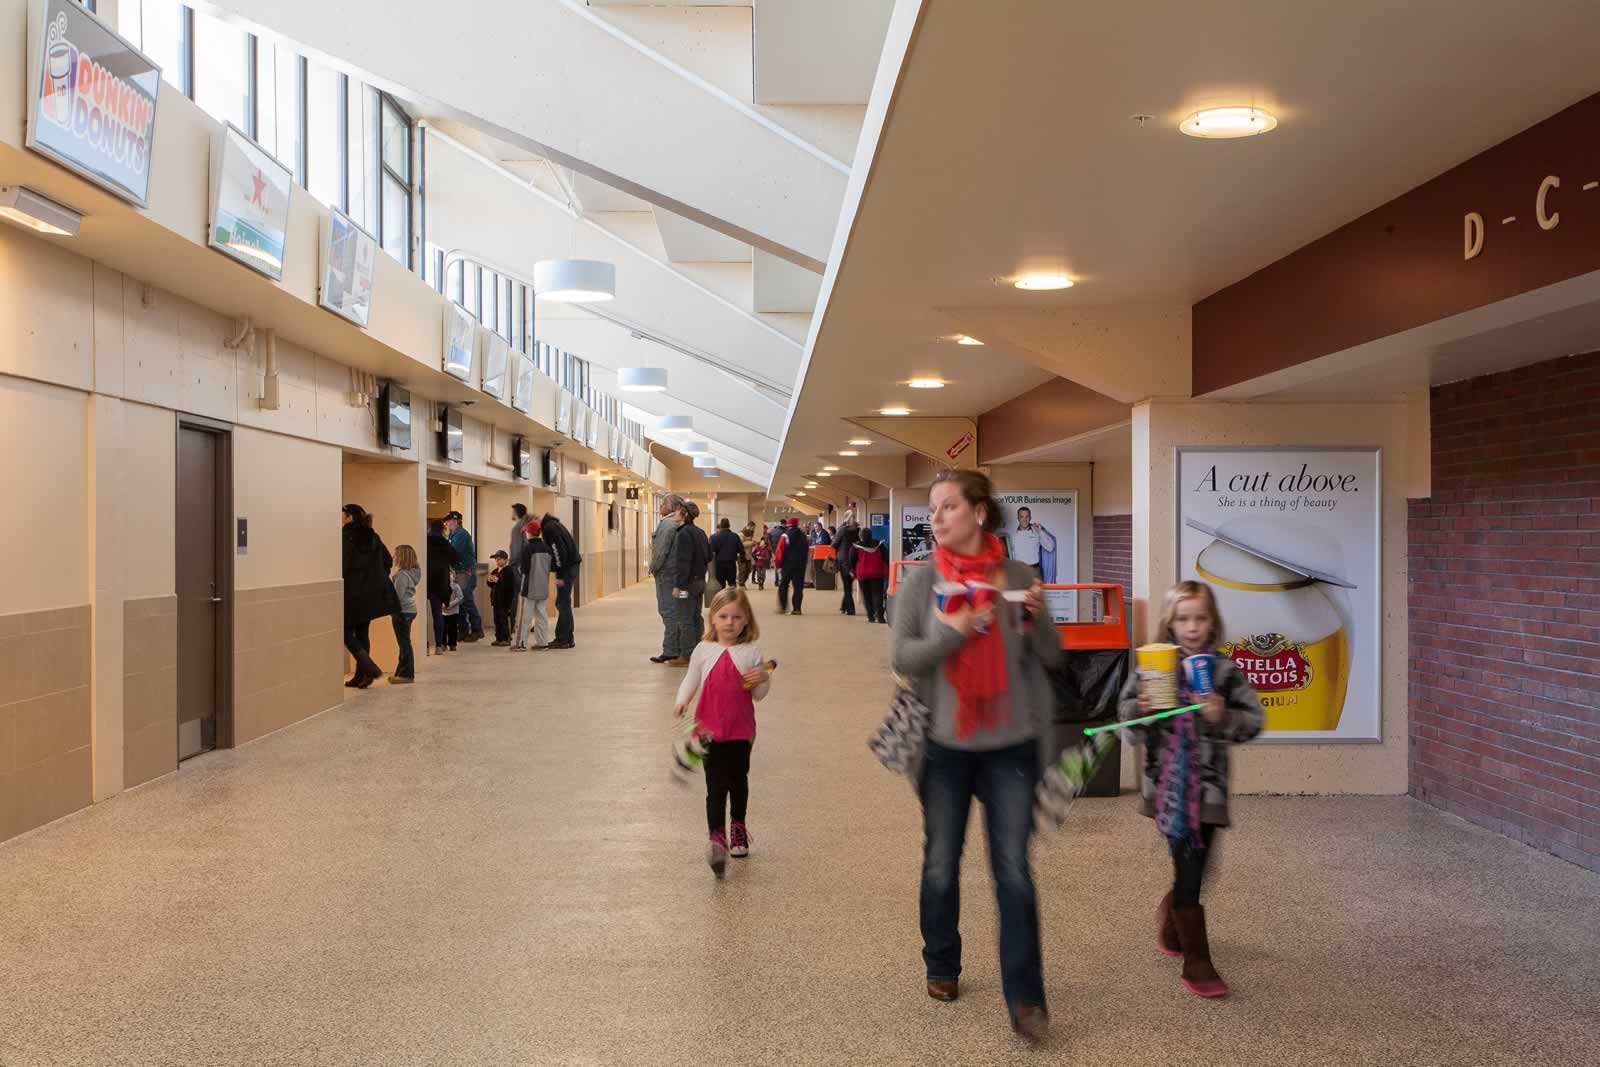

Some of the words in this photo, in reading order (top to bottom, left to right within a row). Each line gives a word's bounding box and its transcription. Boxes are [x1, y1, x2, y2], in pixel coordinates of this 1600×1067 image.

[77, 54, 153, 132] DUNKIN'
[73, 97, 145, 173] DONUTS
[1464, 212, 1484, 260] D
[1536, 175, 1560, 230] C
[1193, 464, 1219, 492] A
[1229, 471, 1272, 492] cut
[1278, 463, 1359, 492] above.
[1004, 495, 1023, 504] YOUR
[1024, 495, 1051, 504] Business
[1052, 495, 1072, 506] Image
[1217, 496, 1235, 507] She
[1239, 497, 1246, 507] is
[1250, 499, 1256, 507] a
[1259, 497, 1286, 511] thing
[1290, 496, 1303, 511] of
[1303, 496, 1338, 511] beauty
[905, 514, 924, 522] Dine
[1235, 657, 1297, 671] STELLA
[1247, 670, 1298, 685] RTOIS
